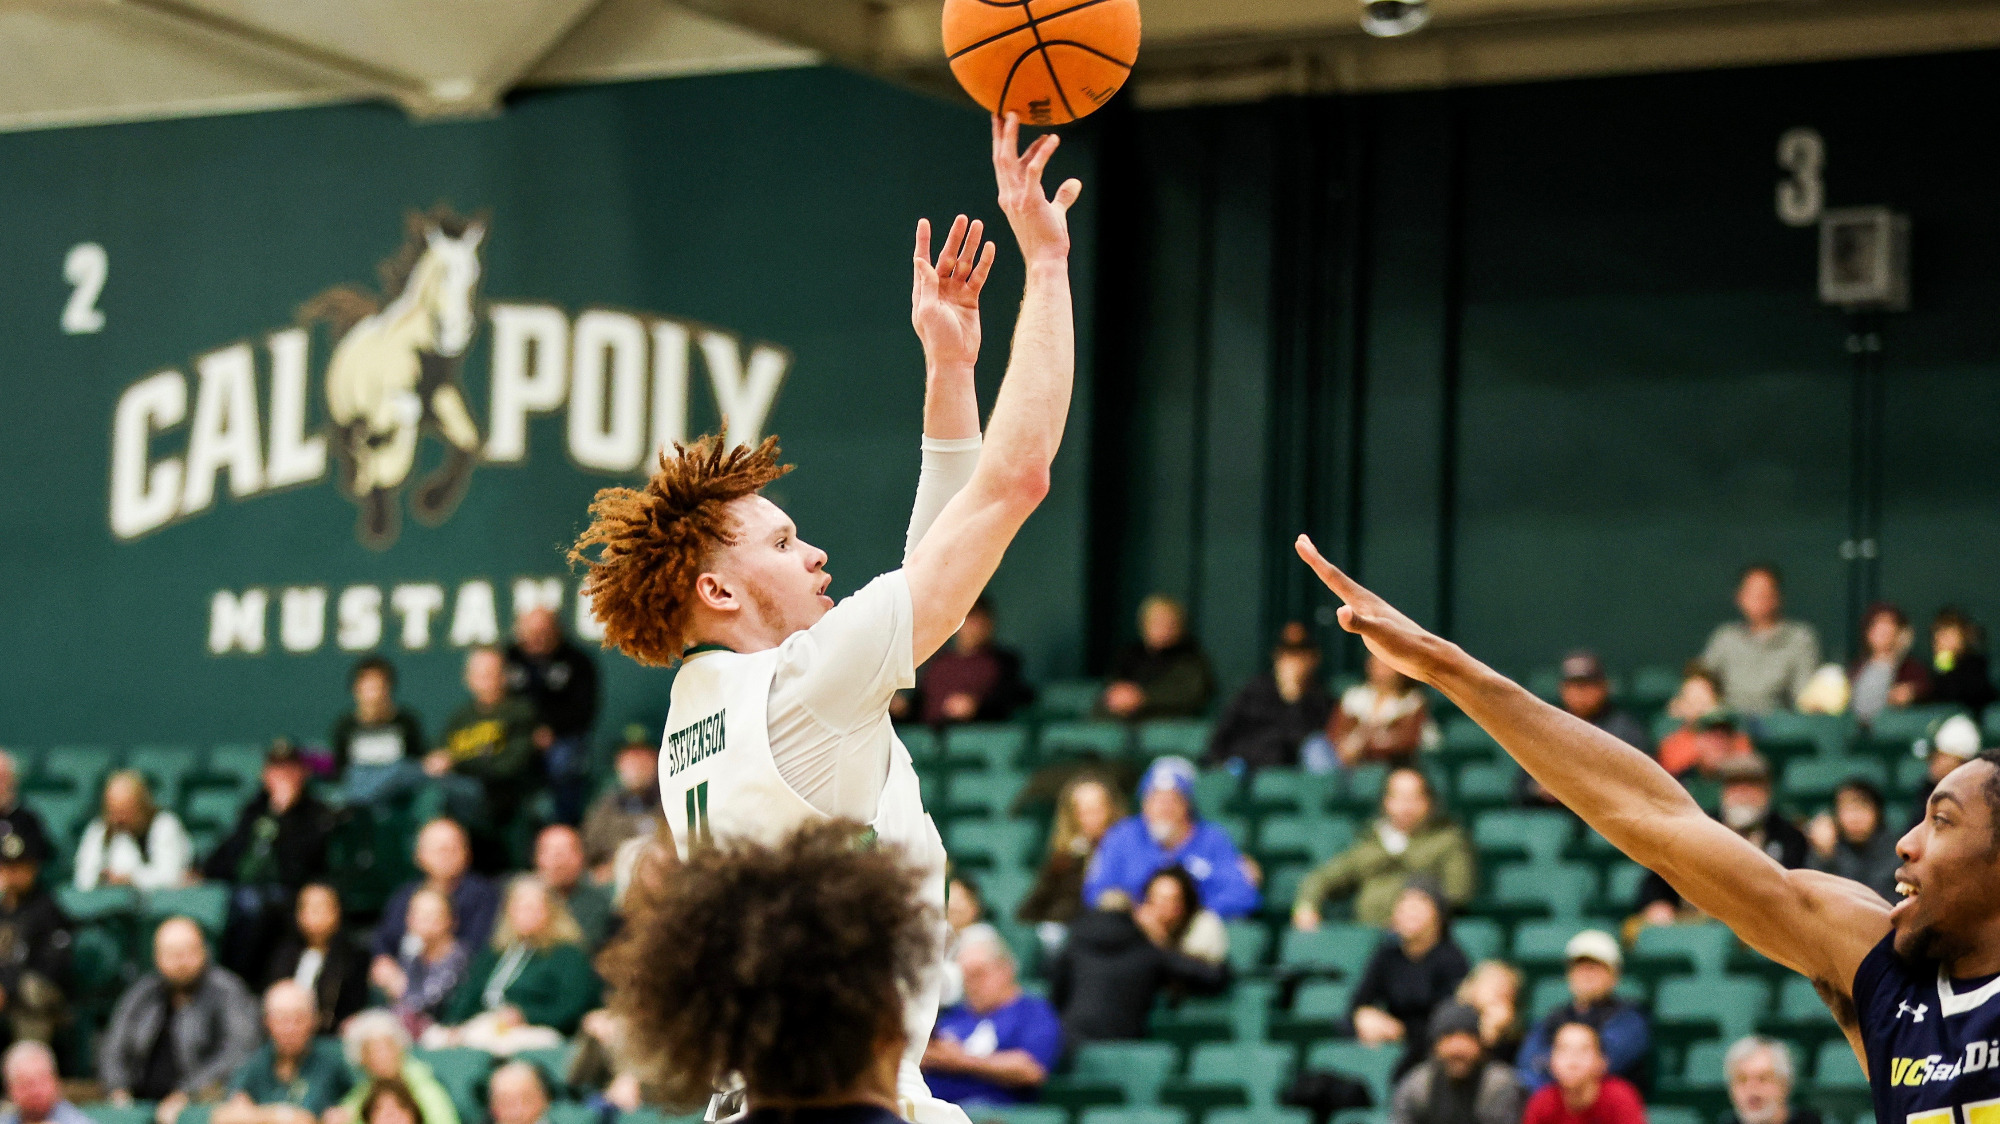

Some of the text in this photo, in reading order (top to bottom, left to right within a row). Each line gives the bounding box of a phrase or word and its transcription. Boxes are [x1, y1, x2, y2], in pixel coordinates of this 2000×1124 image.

[1777, 128, 1824, 226] 3
[62, 242, 108, 333] 2
[110, 304, 788, 538] CAL POLY
[668, 707, 726, 778] STEVENSON
